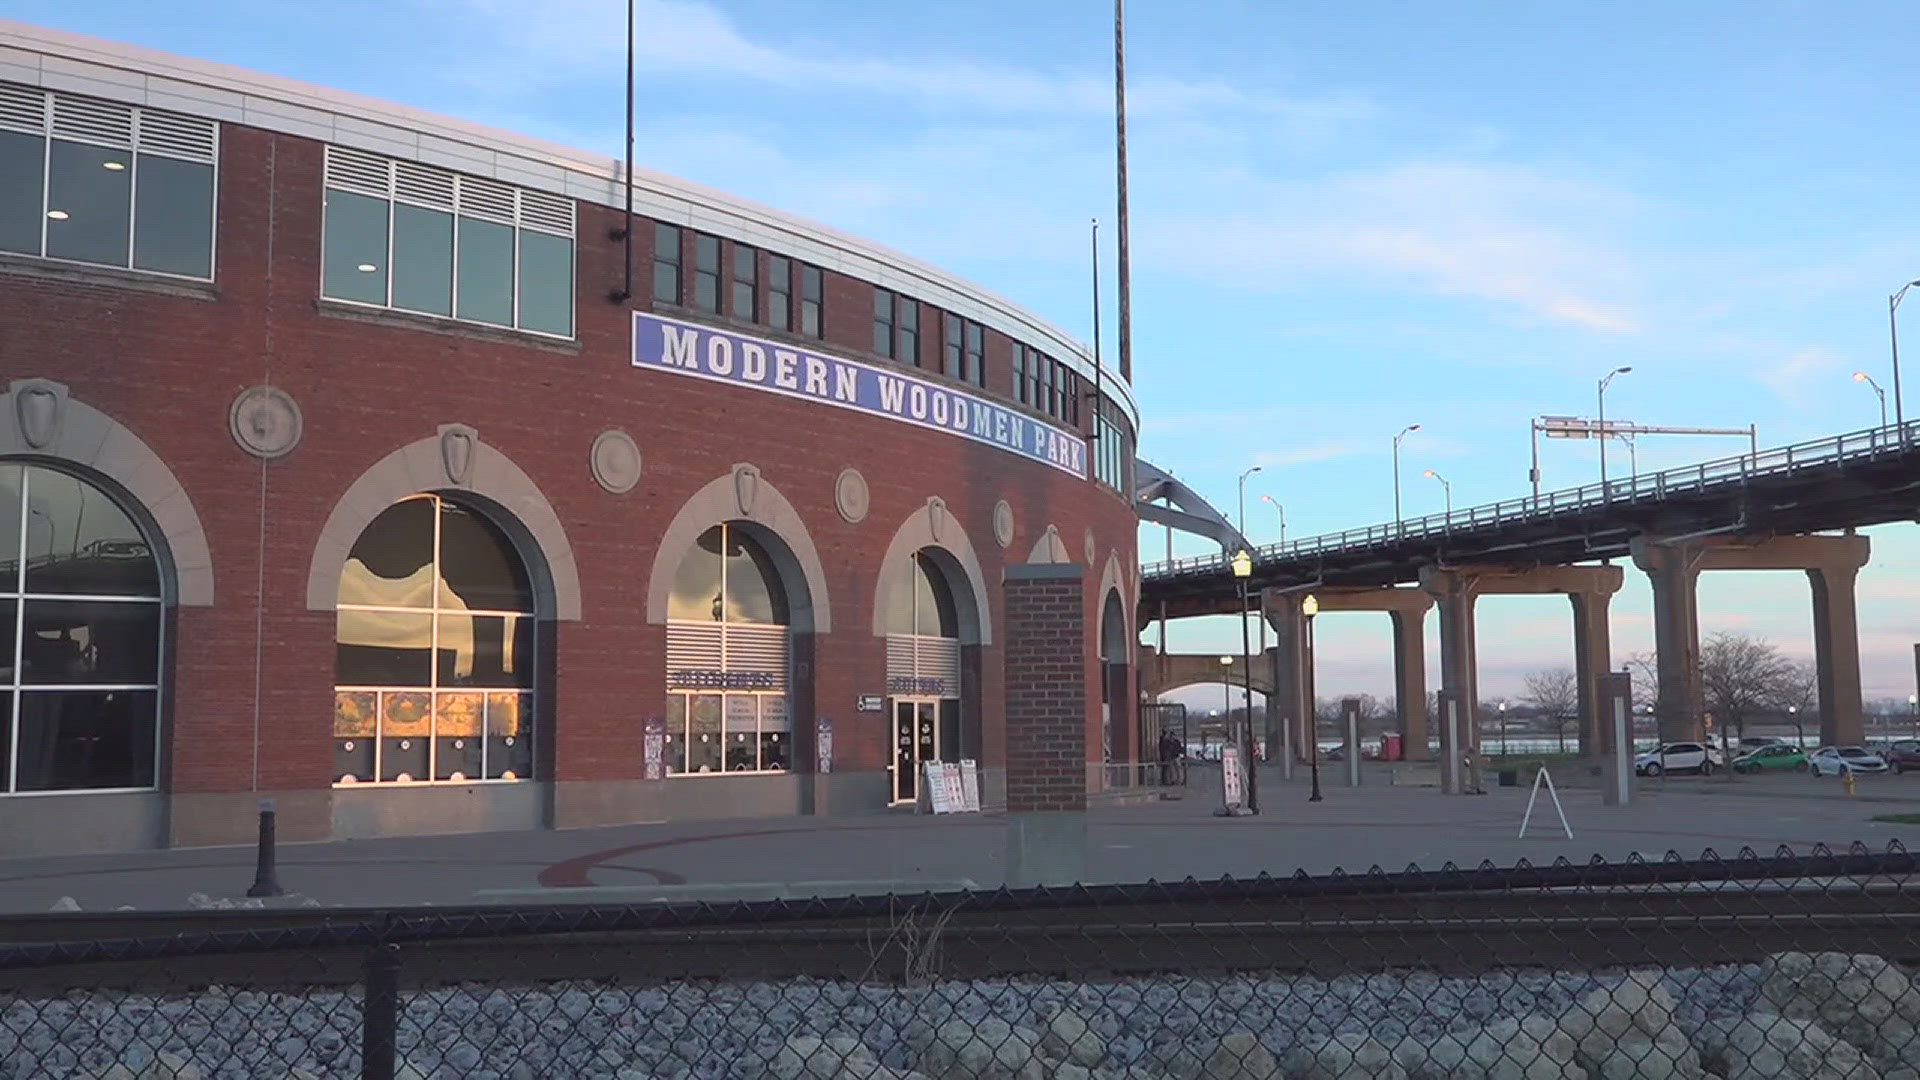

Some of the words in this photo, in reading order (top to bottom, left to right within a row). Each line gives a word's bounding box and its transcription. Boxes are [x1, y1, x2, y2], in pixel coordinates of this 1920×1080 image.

[661, 324, 857, 403] MODERN
[877, 375, 1024, 449] WOODMEN
[1034, 425, 1081, 472] PARK
